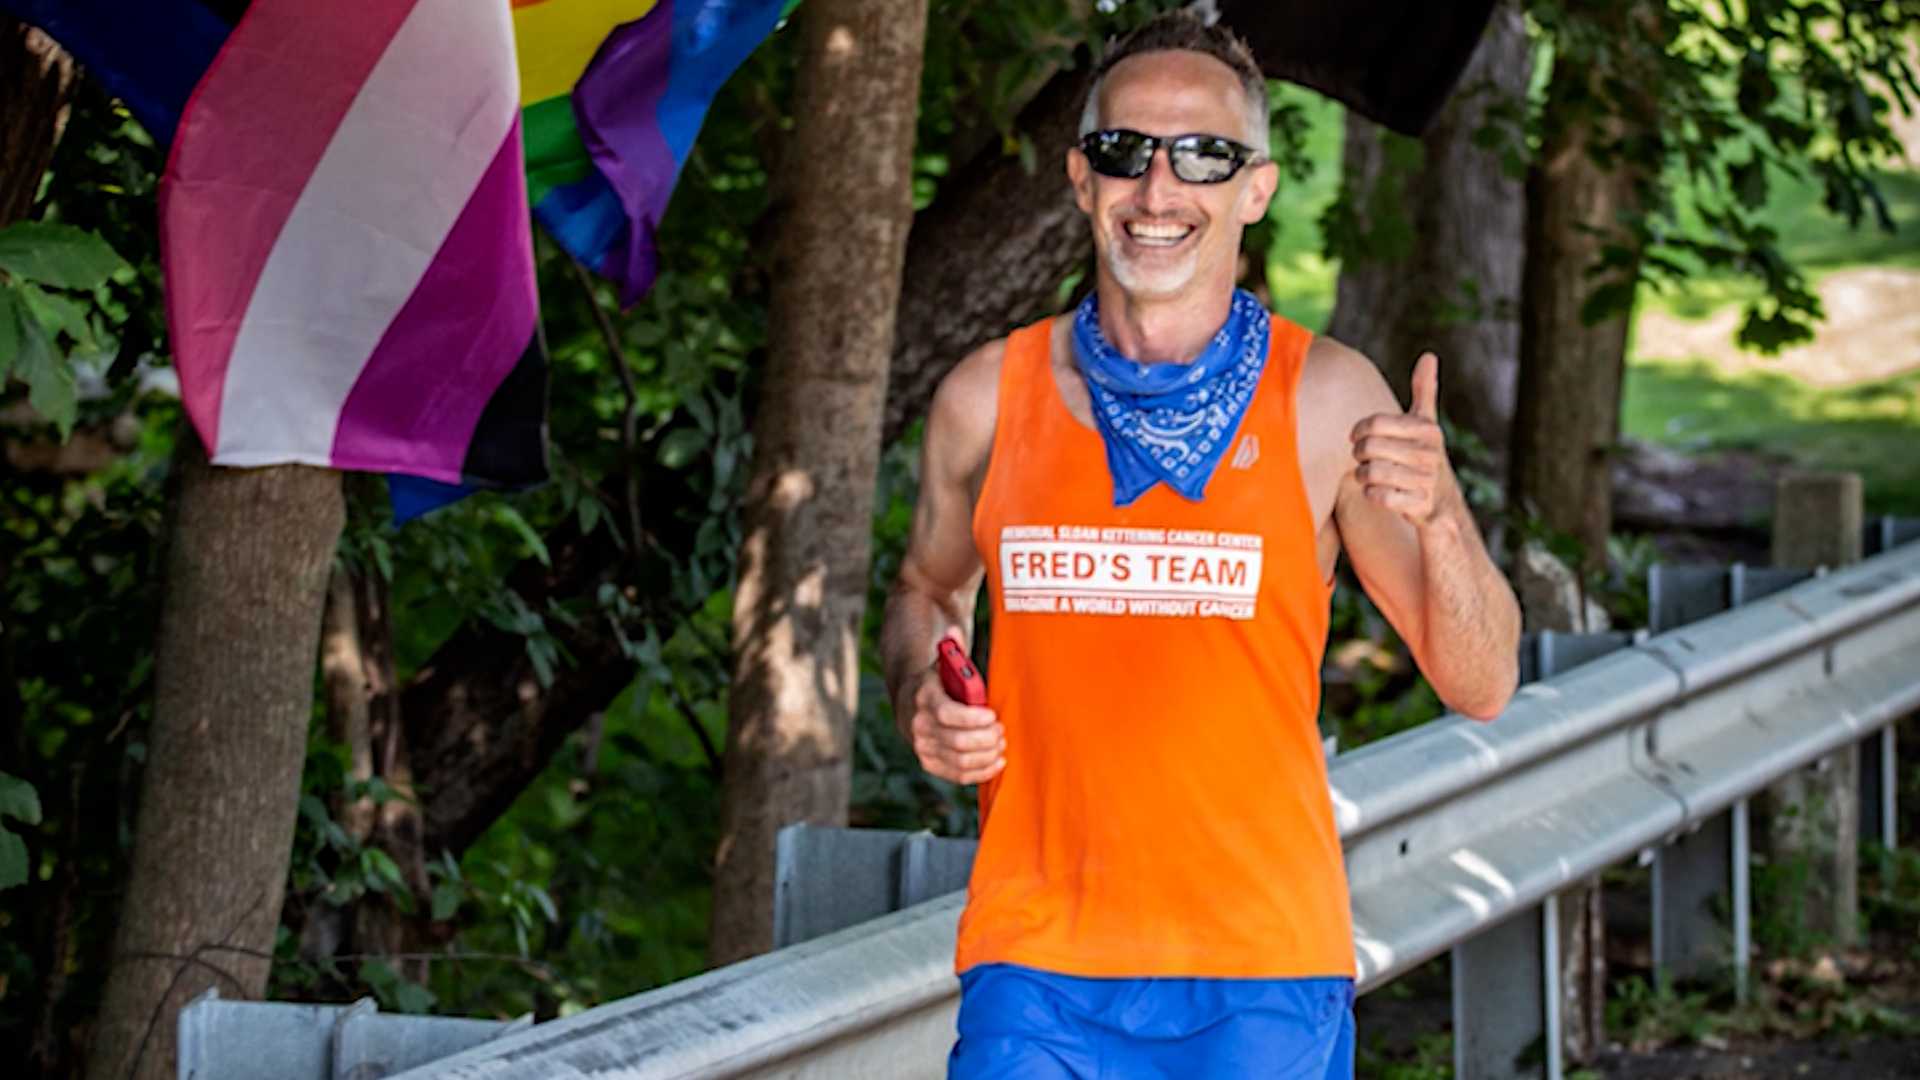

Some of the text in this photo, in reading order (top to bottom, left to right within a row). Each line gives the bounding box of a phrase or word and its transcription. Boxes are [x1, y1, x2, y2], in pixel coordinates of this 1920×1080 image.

[1058, 526, 1100, 541] SLOAN
[1102, 528, 1166, 544] KETTERING
[1167, 530, 1216, 547] CANCER
[1217, 532, 1262, 550] CENTER
[1010, 551, 1246, 586] FRED'S TEAM
[1059, 597, 1073, 613] A
[1072, 598, 1127, 616] WORLD
[1129, 600, 1196, 617] WITHOUT
[1198, 601, 1255, 620] CANCER
